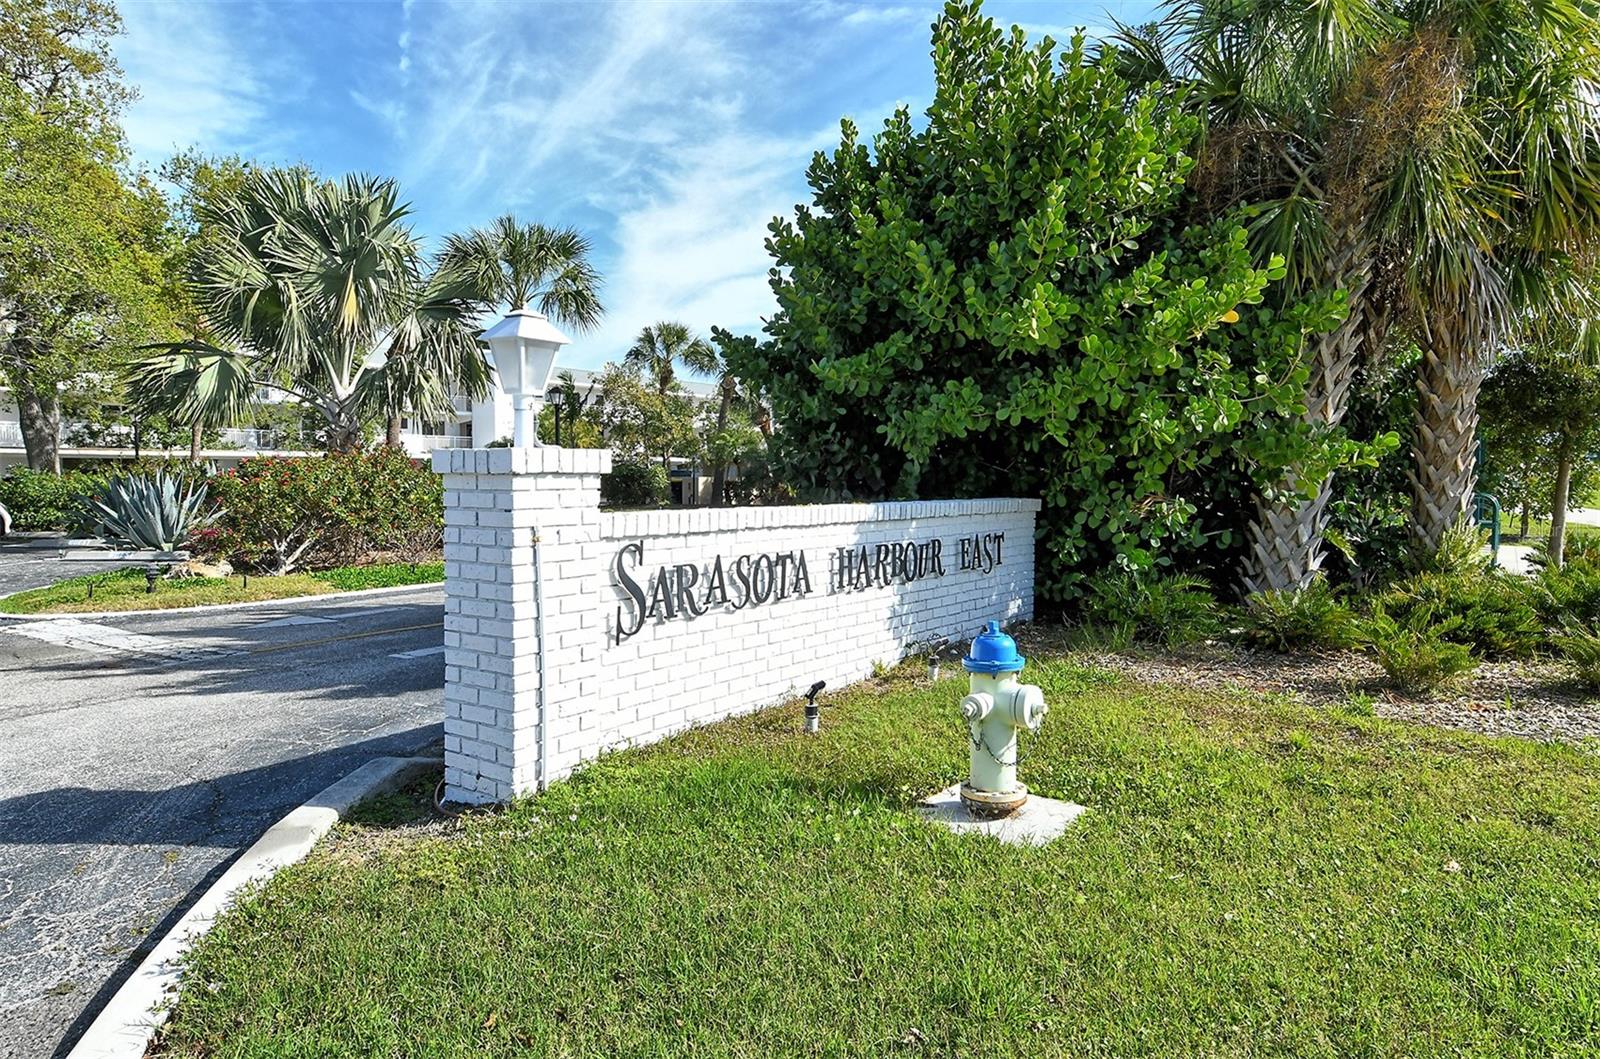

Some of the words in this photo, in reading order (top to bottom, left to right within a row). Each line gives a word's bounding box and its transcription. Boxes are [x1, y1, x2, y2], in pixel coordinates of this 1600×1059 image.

[616, 540, 814, 646] SARASOTA
[835, 538, 946, 588] HARBOUR
[960, 532, 1006, 575] EAST
